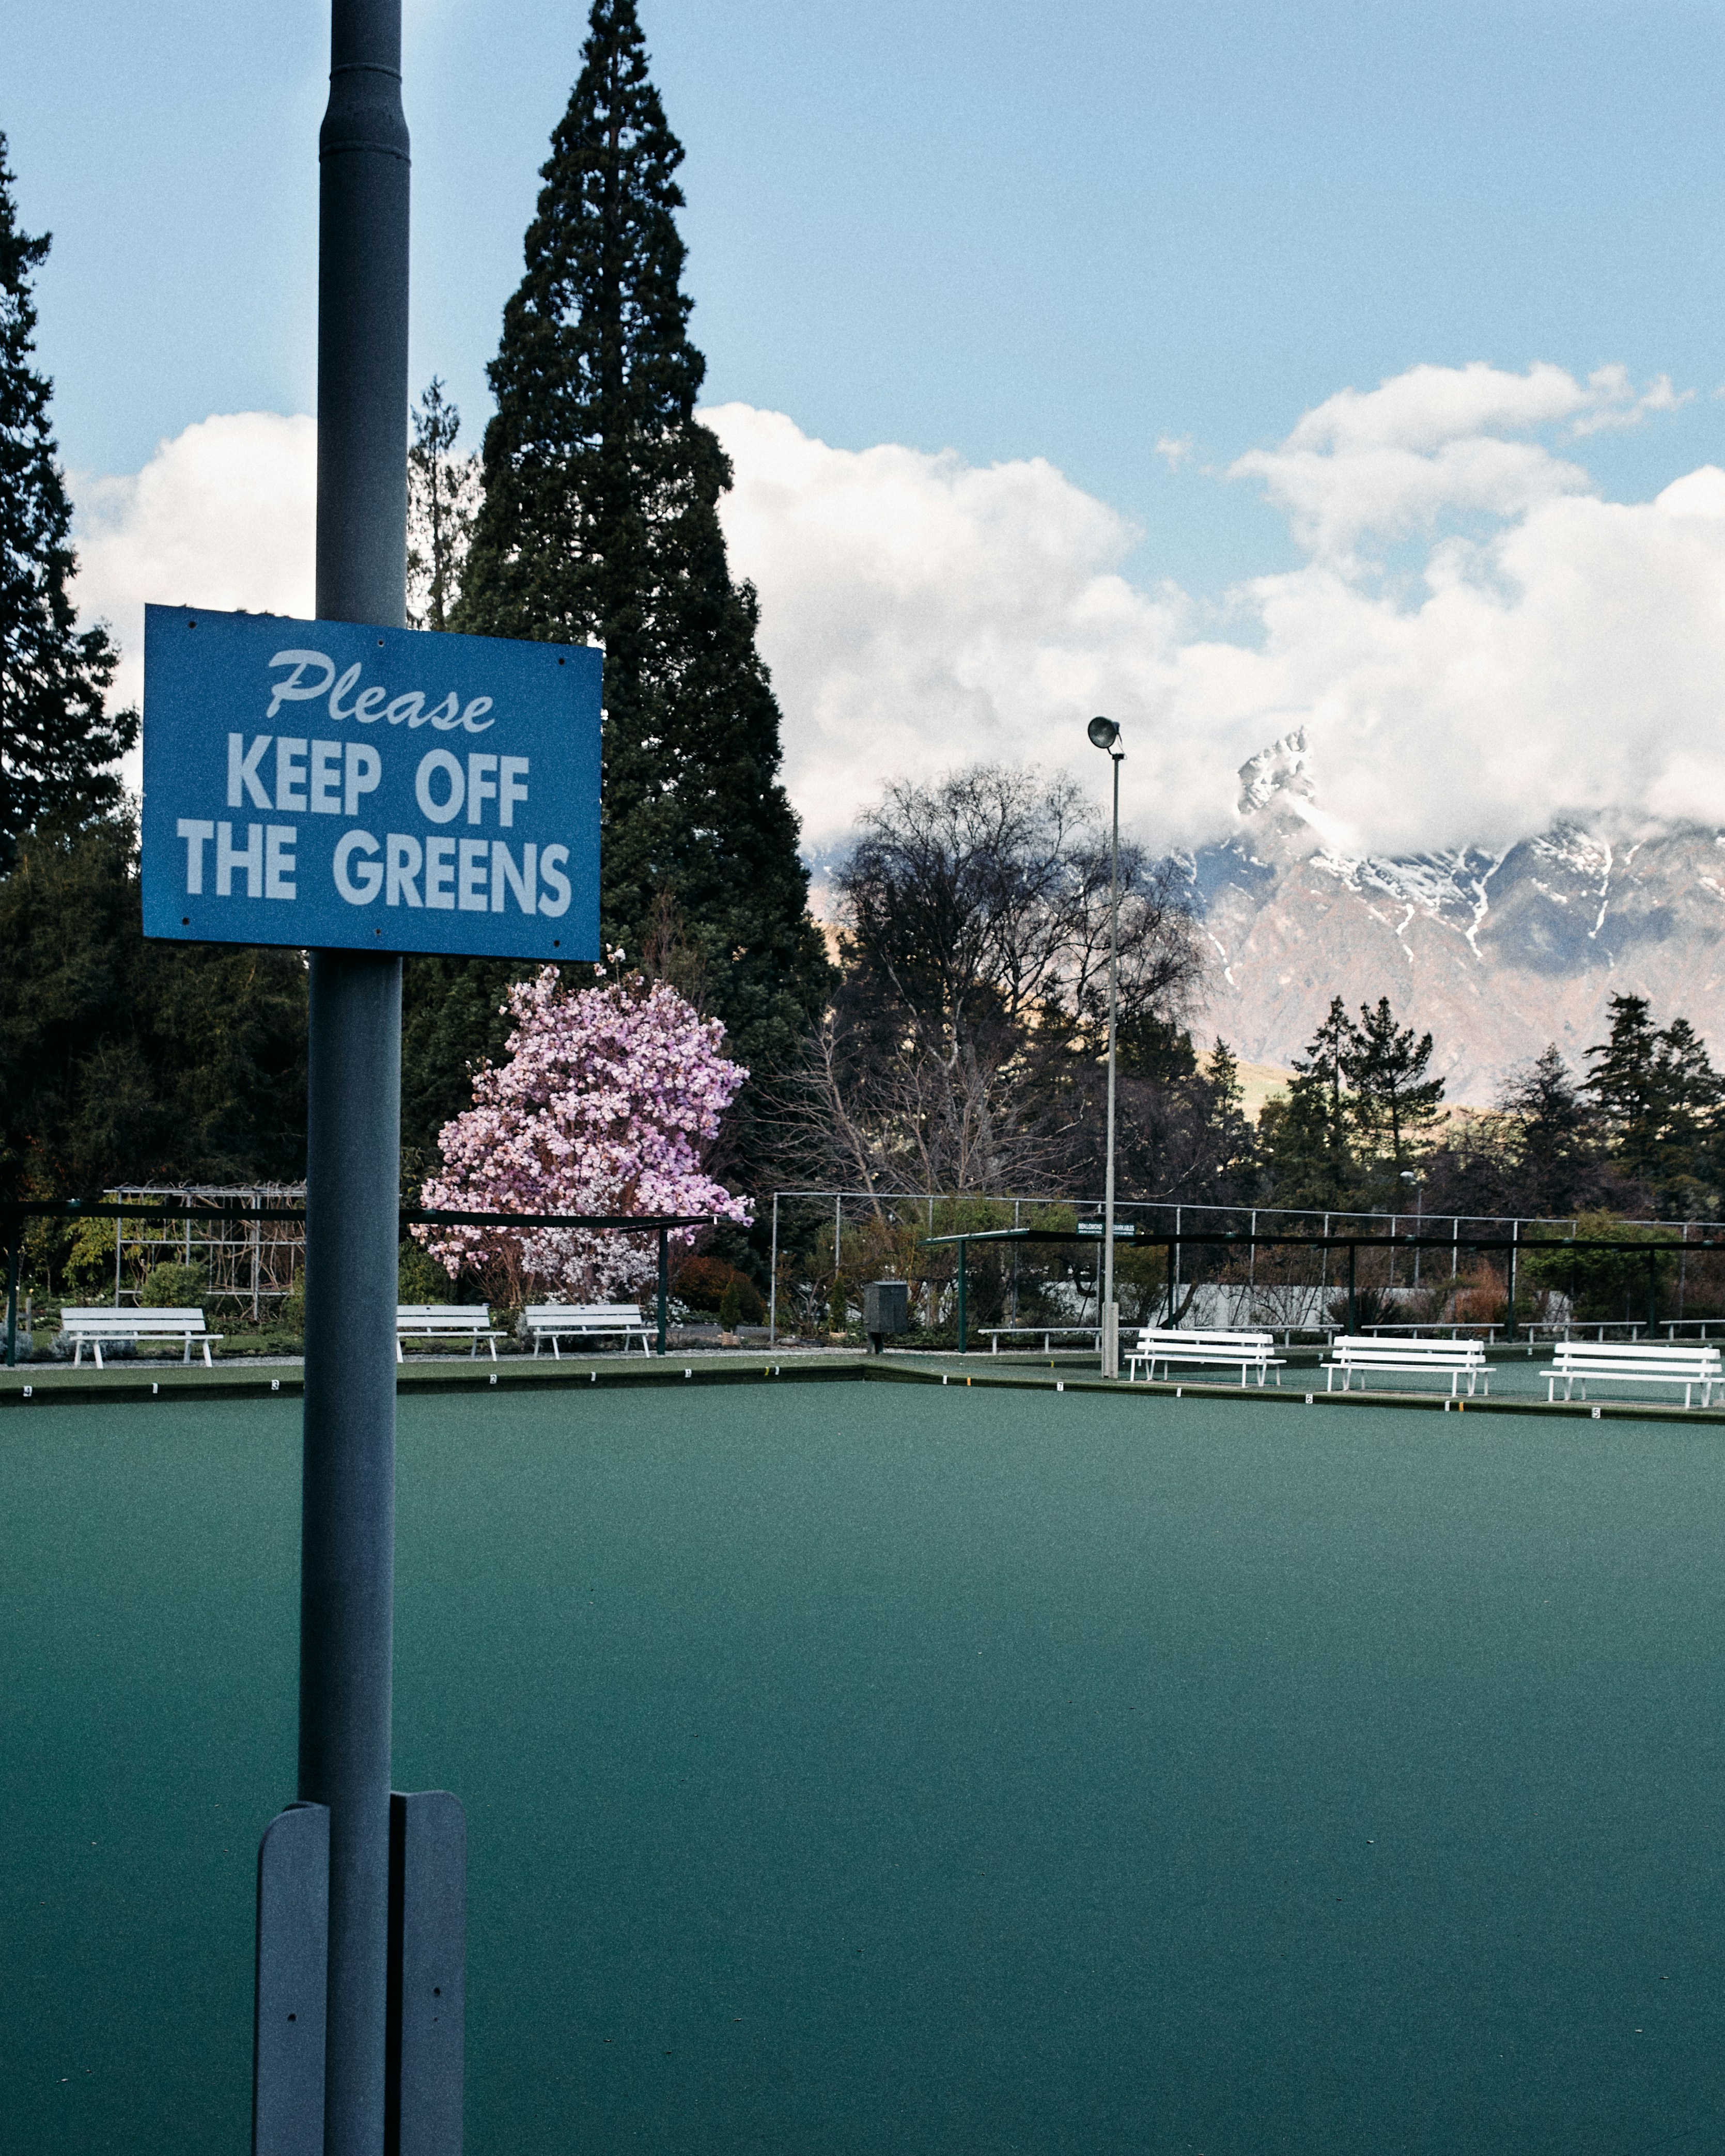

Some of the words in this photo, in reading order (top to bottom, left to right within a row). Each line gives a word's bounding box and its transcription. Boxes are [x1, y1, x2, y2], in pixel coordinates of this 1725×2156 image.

[267, 649, 495, 732] Please
[228, 732, 382, 815] KEEP
[415, 748, 530, 827] OFF
[177, 818, 298, 900] THE
[333, 830, 572, 918] GREENS
